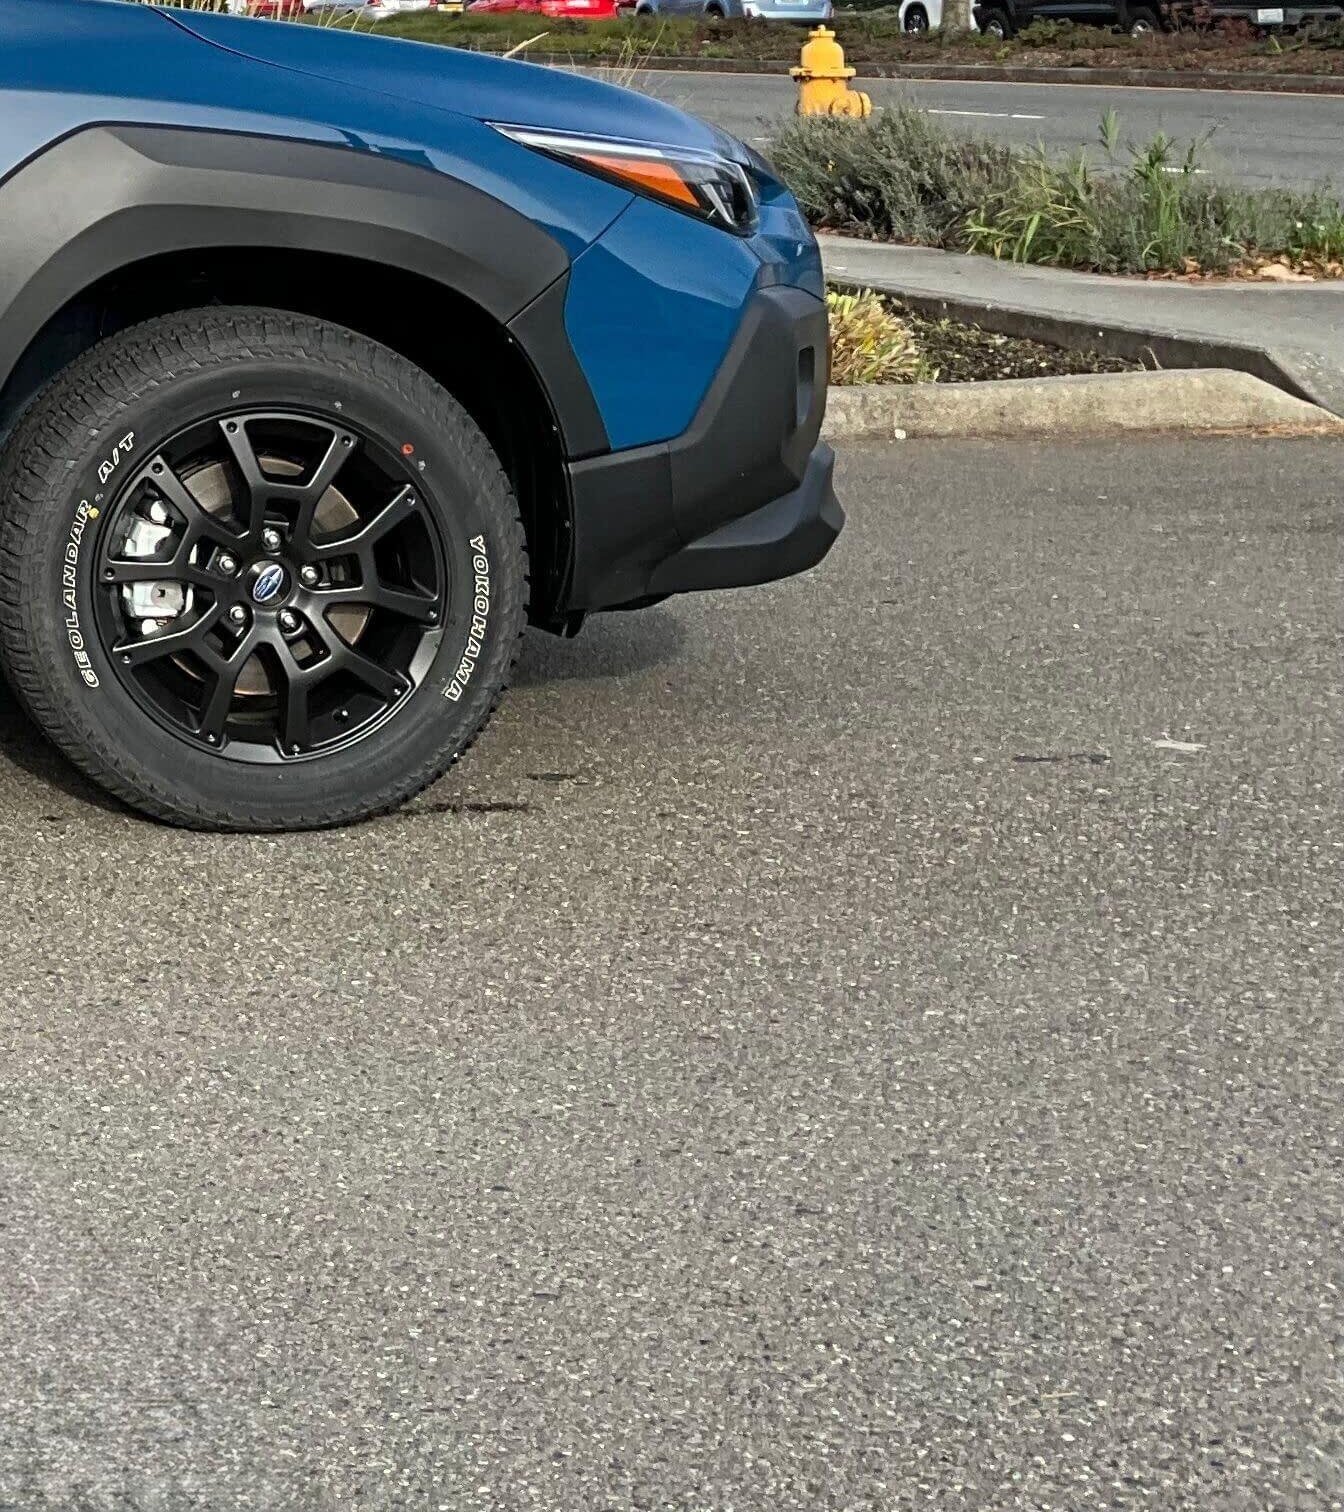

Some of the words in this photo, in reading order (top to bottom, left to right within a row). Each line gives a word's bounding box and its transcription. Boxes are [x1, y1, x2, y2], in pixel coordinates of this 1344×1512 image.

[63, 498, 100, 688] GEOLANDAR
[97, 431, 135, 483] A/T
[444, 535, 490, 702] YOKOHAMA
